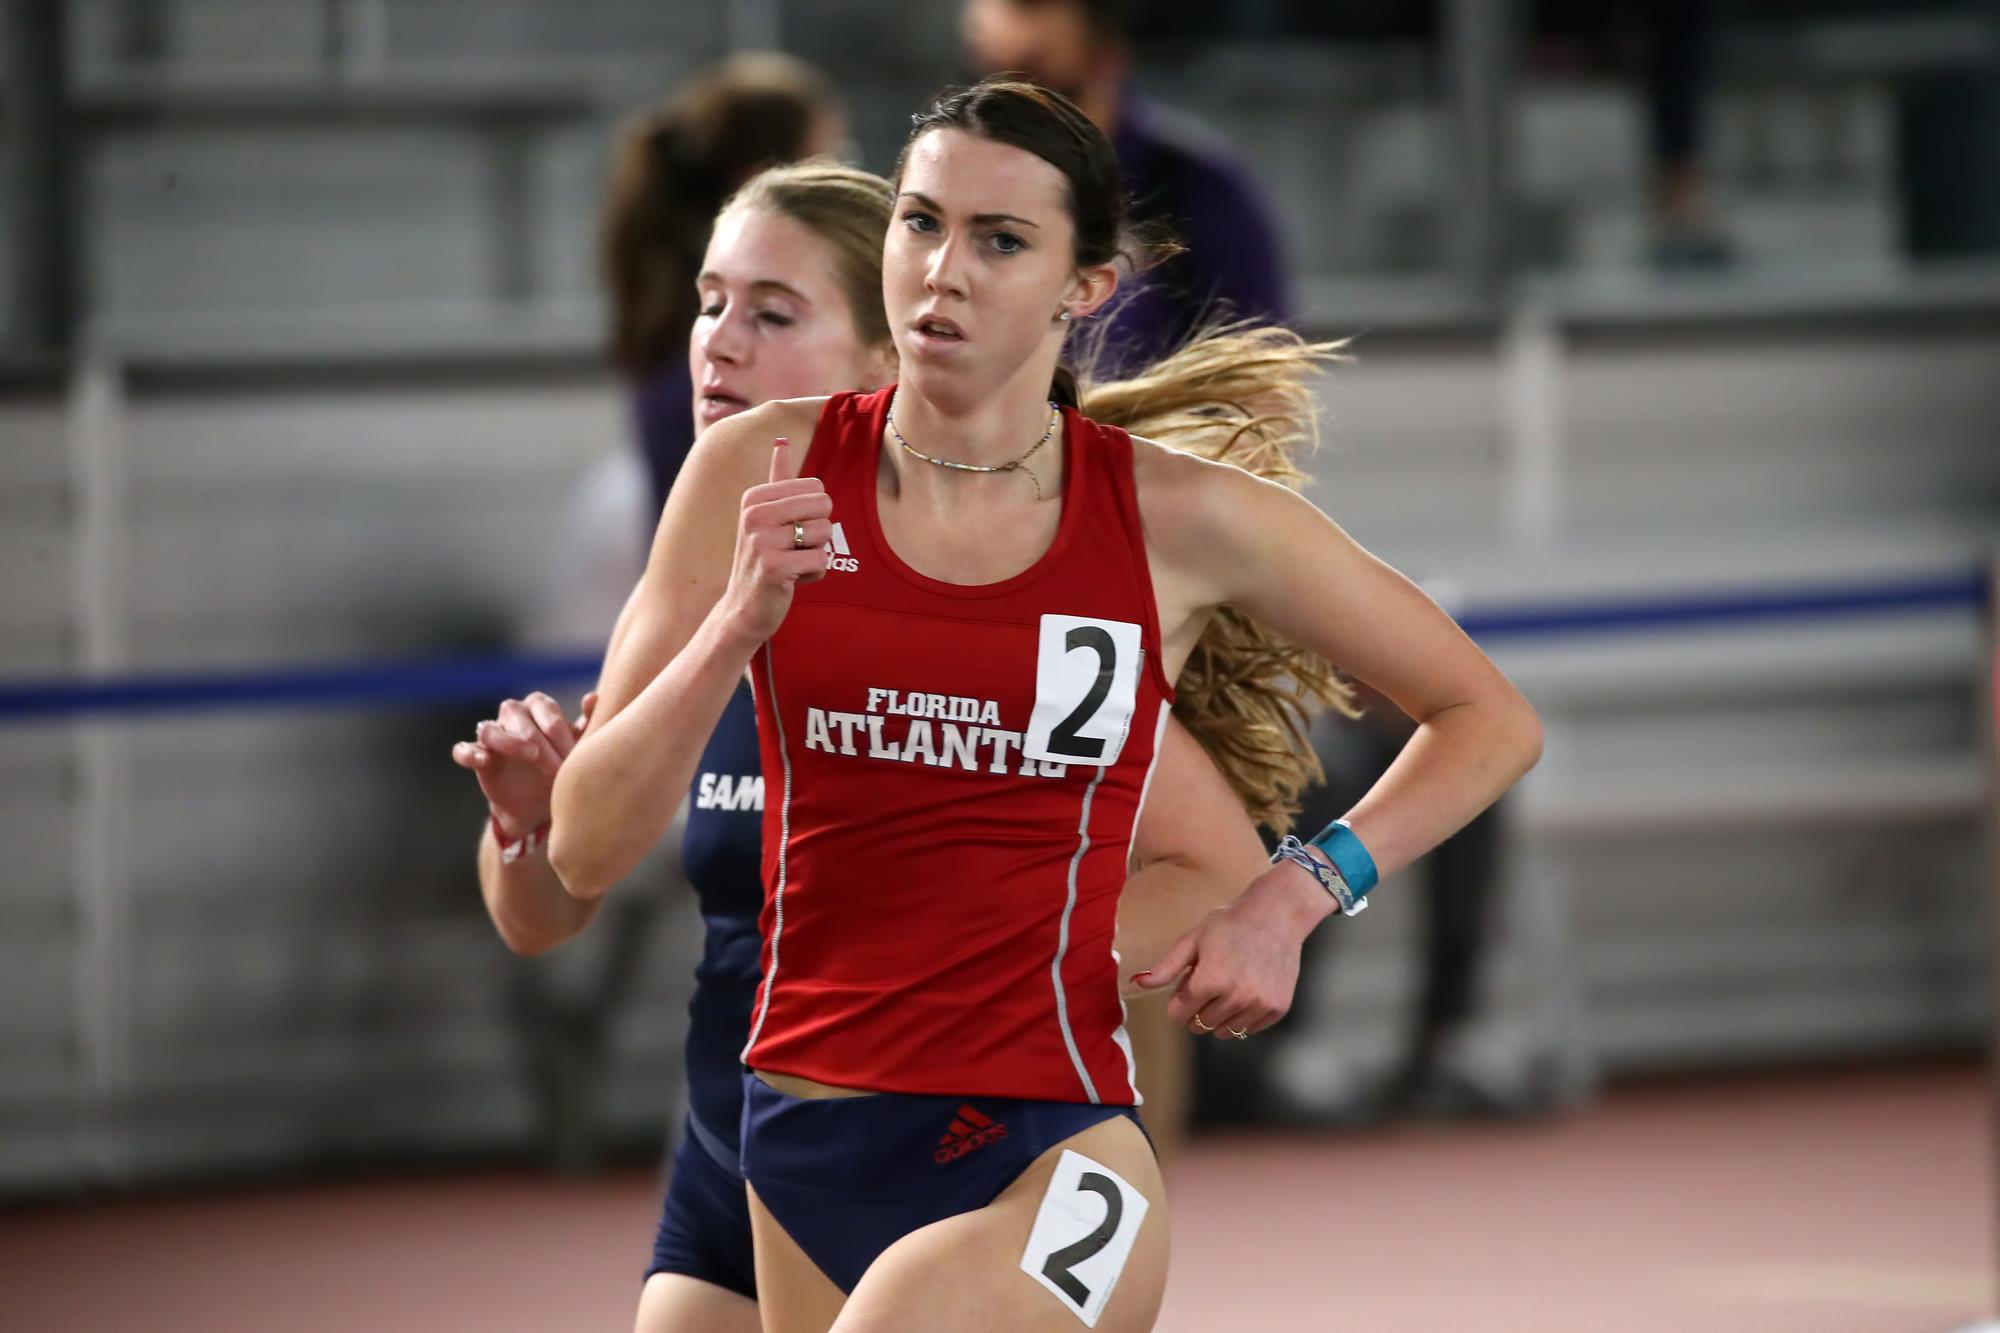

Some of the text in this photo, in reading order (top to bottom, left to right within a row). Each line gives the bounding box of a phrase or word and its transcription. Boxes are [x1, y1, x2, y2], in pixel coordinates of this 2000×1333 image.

[866, 687, 1000, 727] FLORIDA
[1045, 625, 1116, 759] 2
[696, 772, 765, 812] SAM
[933, 1123, 1008, 1164] adidas
[1041, 1172, 1123, 1308] 2
